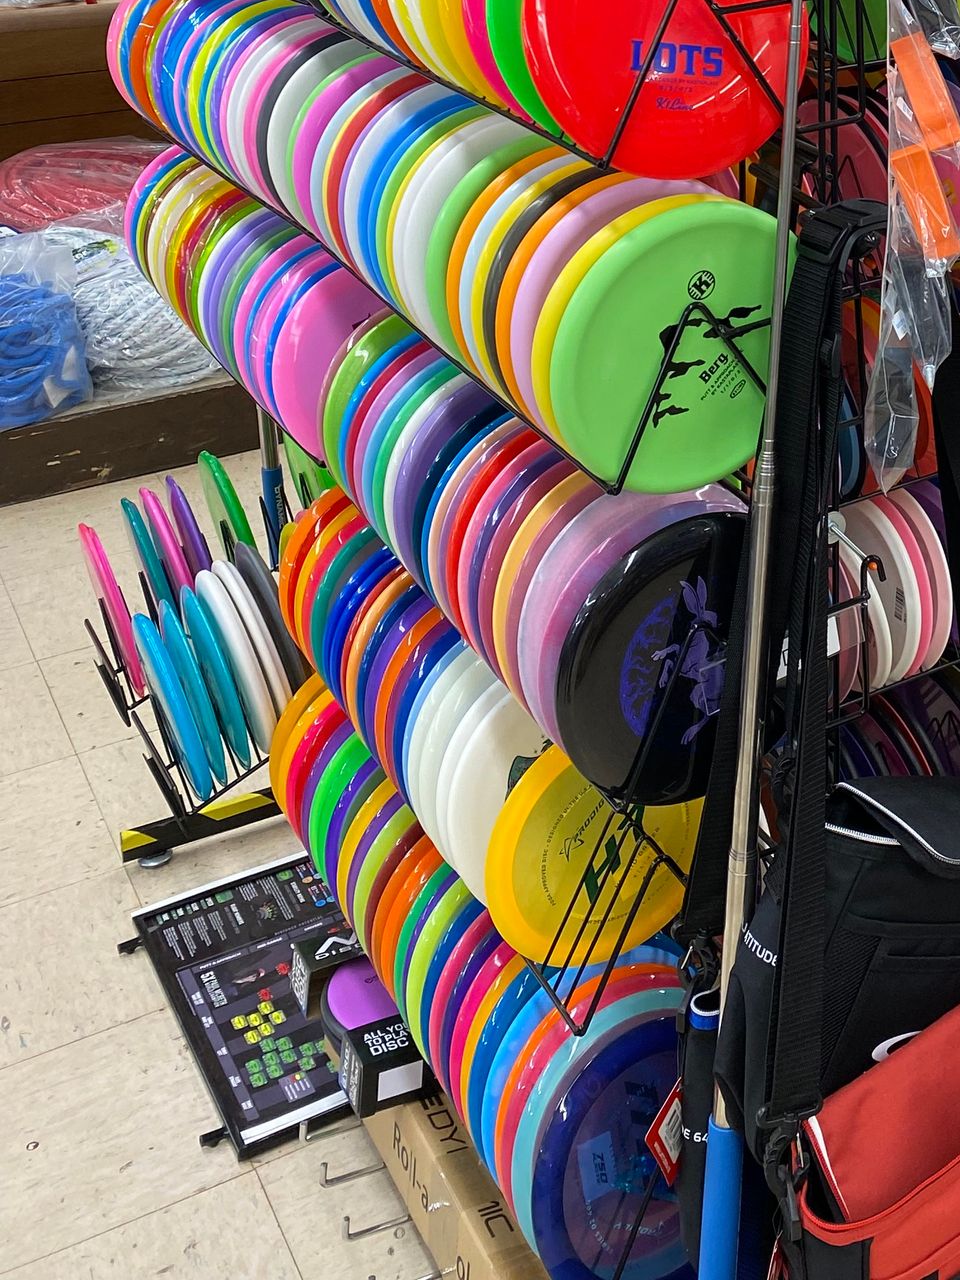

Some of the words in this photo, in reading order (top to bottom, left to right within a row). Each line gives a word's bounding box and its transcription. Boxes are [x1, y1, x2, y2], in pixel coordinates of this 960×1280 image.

[631, 39, 724, 78] LOTS
[698, 352, 729, 385] Berg
[714, 358, 737, 387] APPROACH
[573, 798, 605, 843] PRODIG
[540, 863, 552, 895] APPROVED
[547, 812, 564, 843] DESIGNED
[742, 923, 778, 968] TITUDE
[200, 970, 215, 984] 5X
[363, 1030, 386, 1042] ALL
[364, 1037, 383, 1047] TO
[369, 1037, 409, 1057] DISC
